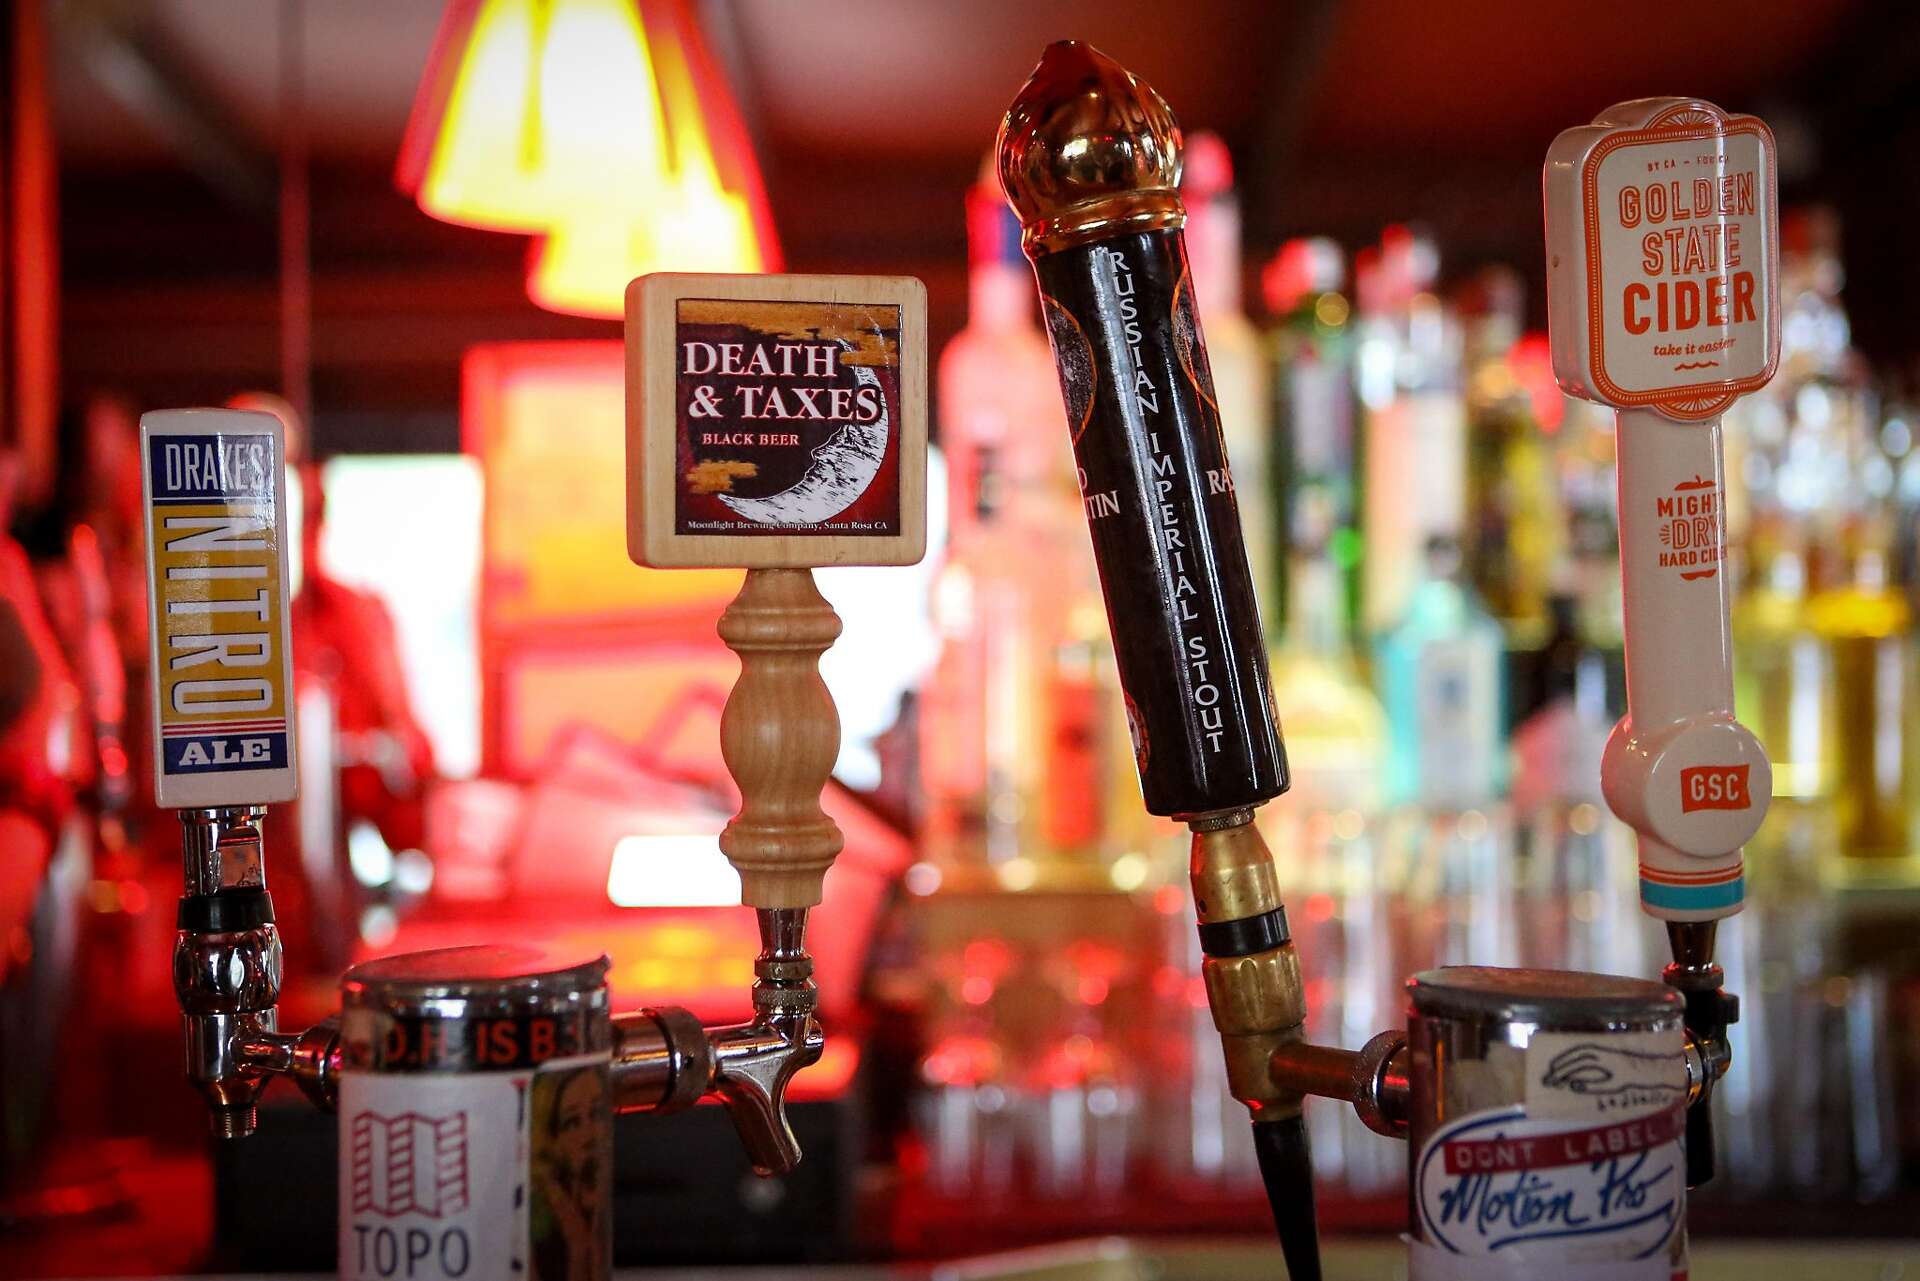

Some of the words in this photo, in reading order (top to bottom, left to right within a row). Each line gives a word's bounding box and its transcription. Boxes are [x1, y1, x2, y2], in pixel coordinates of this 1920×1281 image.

[1647, 161, 1660, 172] BY
[1663, 158, 1677, 169] CA
[1619, 171, 1755, 229] GOLDEN
[1641, 223, 1741, 276] STATE
[1622, 271, 1757, 336] CIDER
[682, 341, 838, 377] DEATH
[1653, 343, 1682, 356] take
[1686, 343, 1696, 355] it
[1698, 338, 1736, 354] easier
[687, 384, 724, 419] &
[734, 385, 881, 421] TAXES
[702, 432, 753, 446] BLACK
[758, 433, 800, 446] BEER
[164, 442, 267, 492] DRAKE'S
[1084, 489, 1121, 519] TIN
[1109, 251, 1159, 416] RUSSIAN
[1149, 431, 1198, 622] IMPERIAL
[1188, 636, 1224, 753] STOUT
[687, 519, 735, 532] Moonlight
[737, 519, 776, 532] Brewing
[776, 519, 822, 532] Company,
[824, 520, 849, 531] Santa
[851, 520, 873, 531] Rosa
[874, 520, 888, 531] CA
[1659, 551, 1697, 567] HARD
[163, 515, 273, 715] NITRO
[178, 738, 271, 767] ALE
[1690, 773, 1739, 801] GSC
[475, 1020, 519, 1063] IS
[1564, 1125, 1659, 1161] LABEL
[353, 1224, 471, 1279] TOPO
